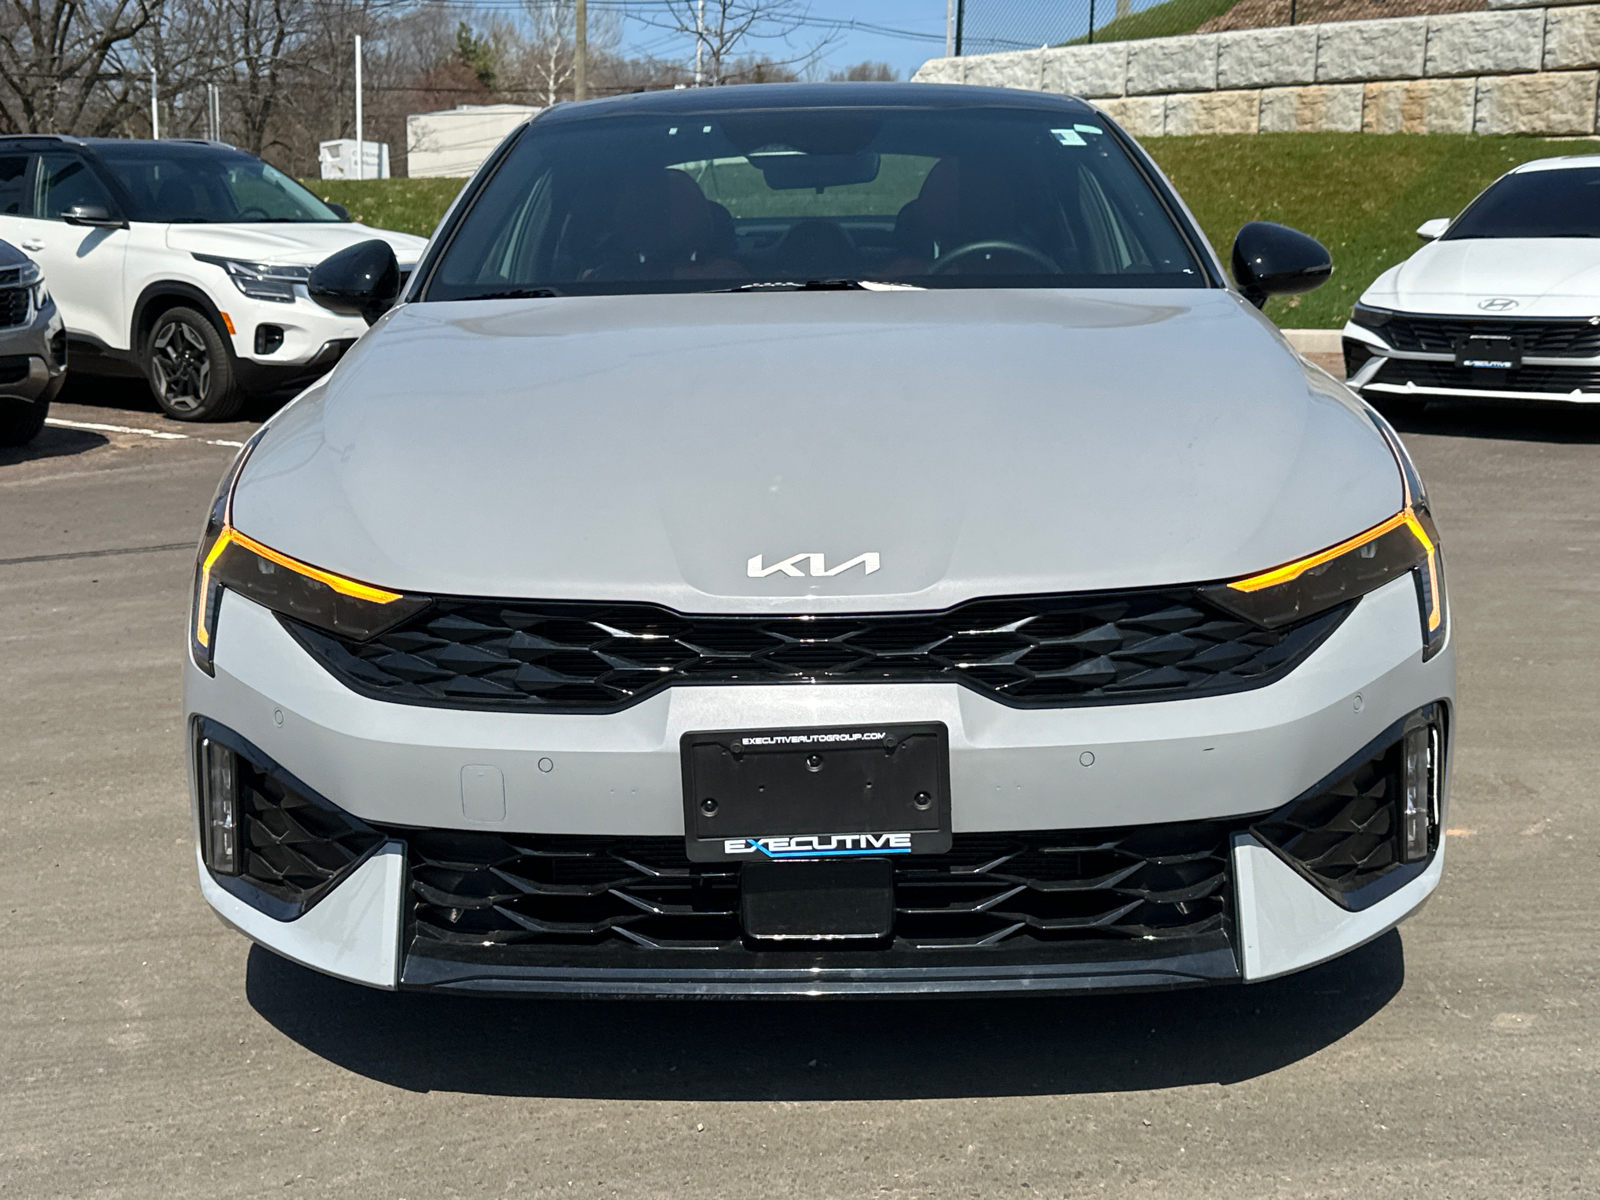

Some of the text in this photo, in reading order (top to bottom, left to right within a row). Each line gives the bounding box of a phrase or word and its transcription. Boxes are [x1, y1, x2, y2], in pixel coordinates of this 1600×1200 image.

[747, 552, 880, 577] KIA
[742, 732, 886, 745] EXECUTIVEAUTOGROUP.COM
[724, 833, 911, 856] EXECUTIVE
